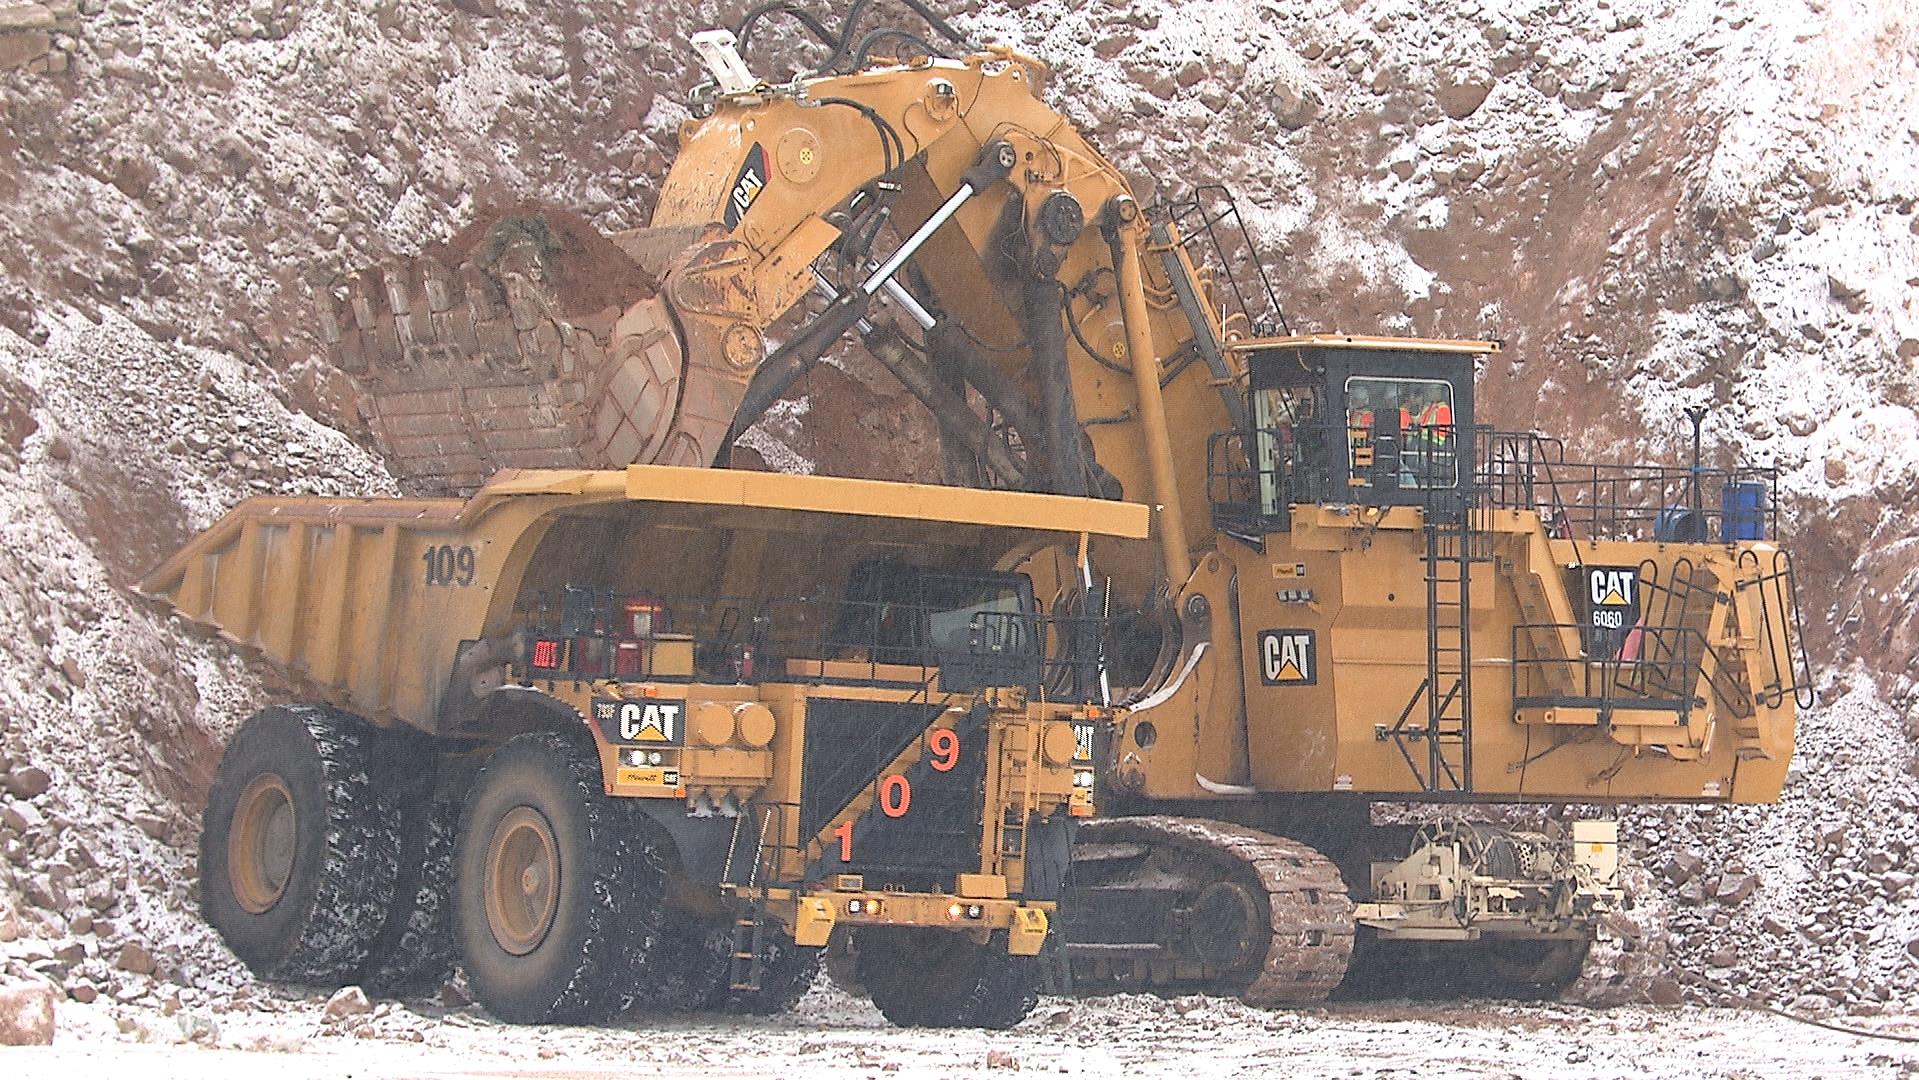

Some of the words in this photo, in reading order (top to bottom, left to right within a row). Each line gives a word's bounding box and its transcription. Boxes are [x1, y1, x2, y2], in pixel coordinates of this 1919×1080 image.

[732, 168, 764, 208] CAT
[423, 545, 475, 587] 109
[1590, 570, 1634, 605] CAT
[1593, 611, 1622, 628] 6060
[1263, 635, 1310, 680] CAT
[620, 704, 679, 741] CAT
[1073, 725, 1095, 760] CAT
